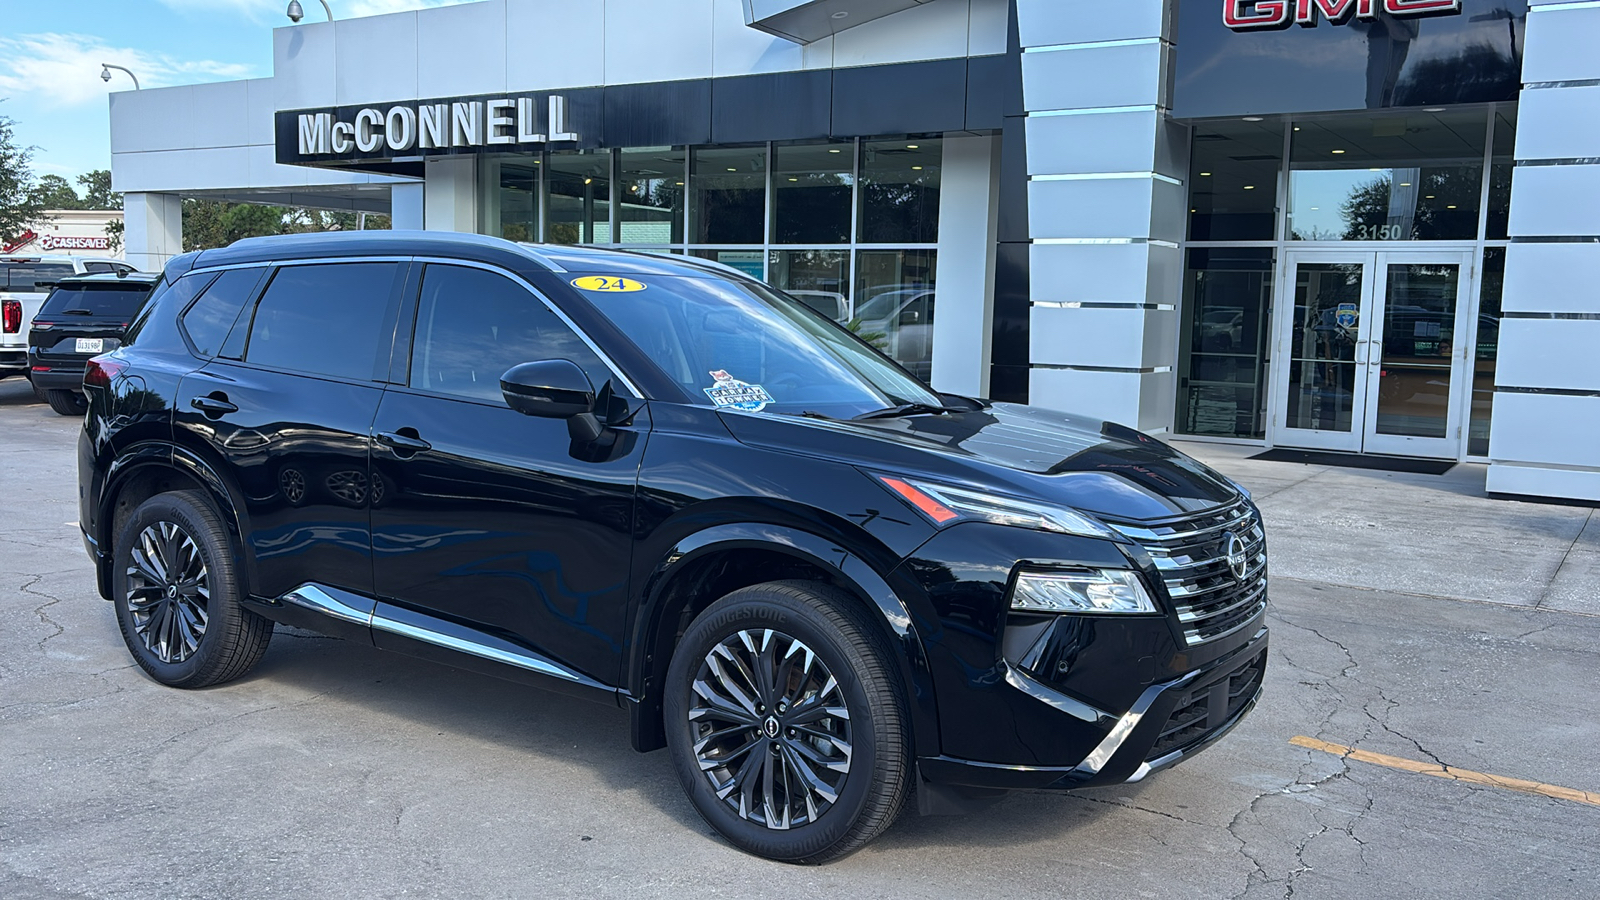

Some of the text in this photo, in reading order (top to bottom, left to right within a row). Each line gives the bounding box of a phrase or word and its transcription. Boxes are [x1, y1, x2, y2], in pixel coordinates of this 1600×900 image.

[1222, 0, 1460, 30] GM
[1357, 224, 1402, 240] 3150
[53, 237, 108, 249] CASHSAVER
[594, 277, 626, 290] 24
[711, 387, 765, 398] CARFAX
[727, 394, 769, 404] OWNER
[1227, 554, 1245, 566] NISS
[697, 606, 787, 640] BRIDGESTONE
